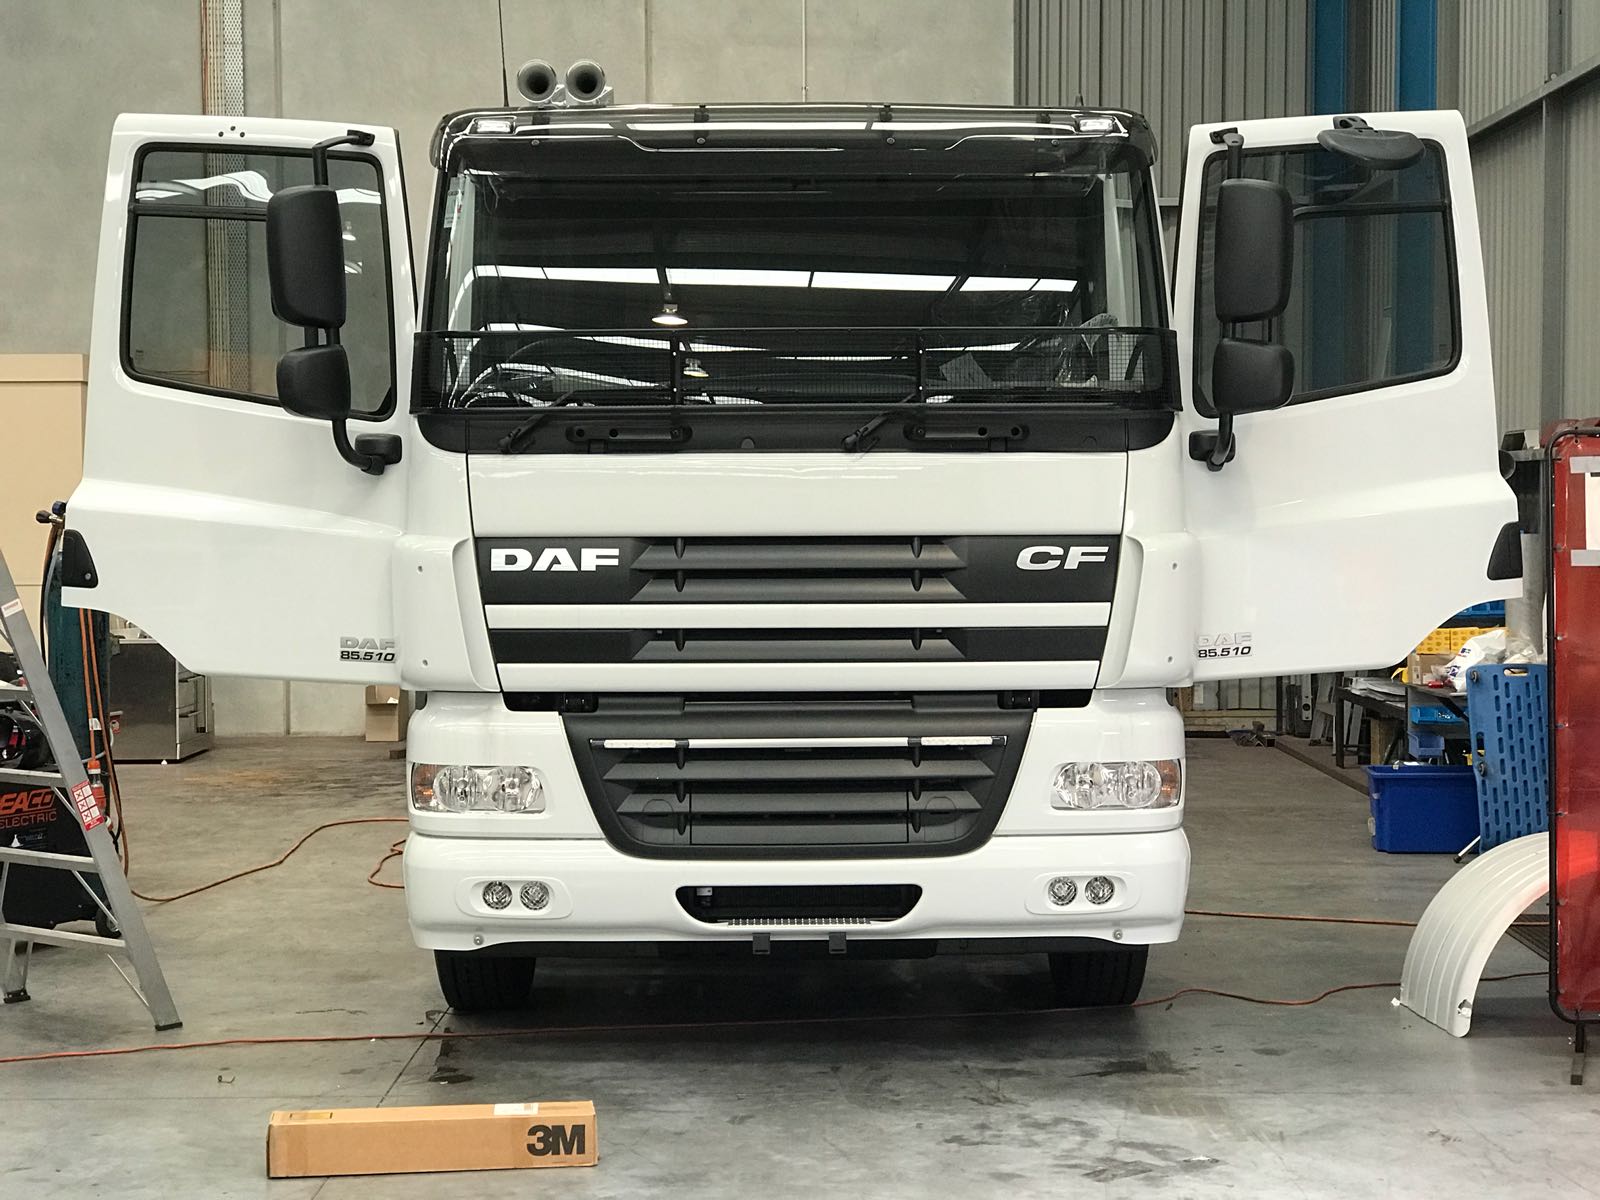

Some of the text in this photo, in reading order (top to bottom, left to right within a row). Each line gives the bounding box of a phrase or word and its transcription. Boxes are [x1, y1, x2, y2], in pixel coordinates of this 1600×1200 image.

[490, 547, 620, 572] DAF
[1016, 545, 1110, 571] CF
[340, 636, 395, 650] DAF
[1198, 631, 1252, 647] DAF
[340, 650, 396, 662] 85.510
[1198, 645, 1252, 658] 85.510
[526, 1124, 586, 1157] 3M
